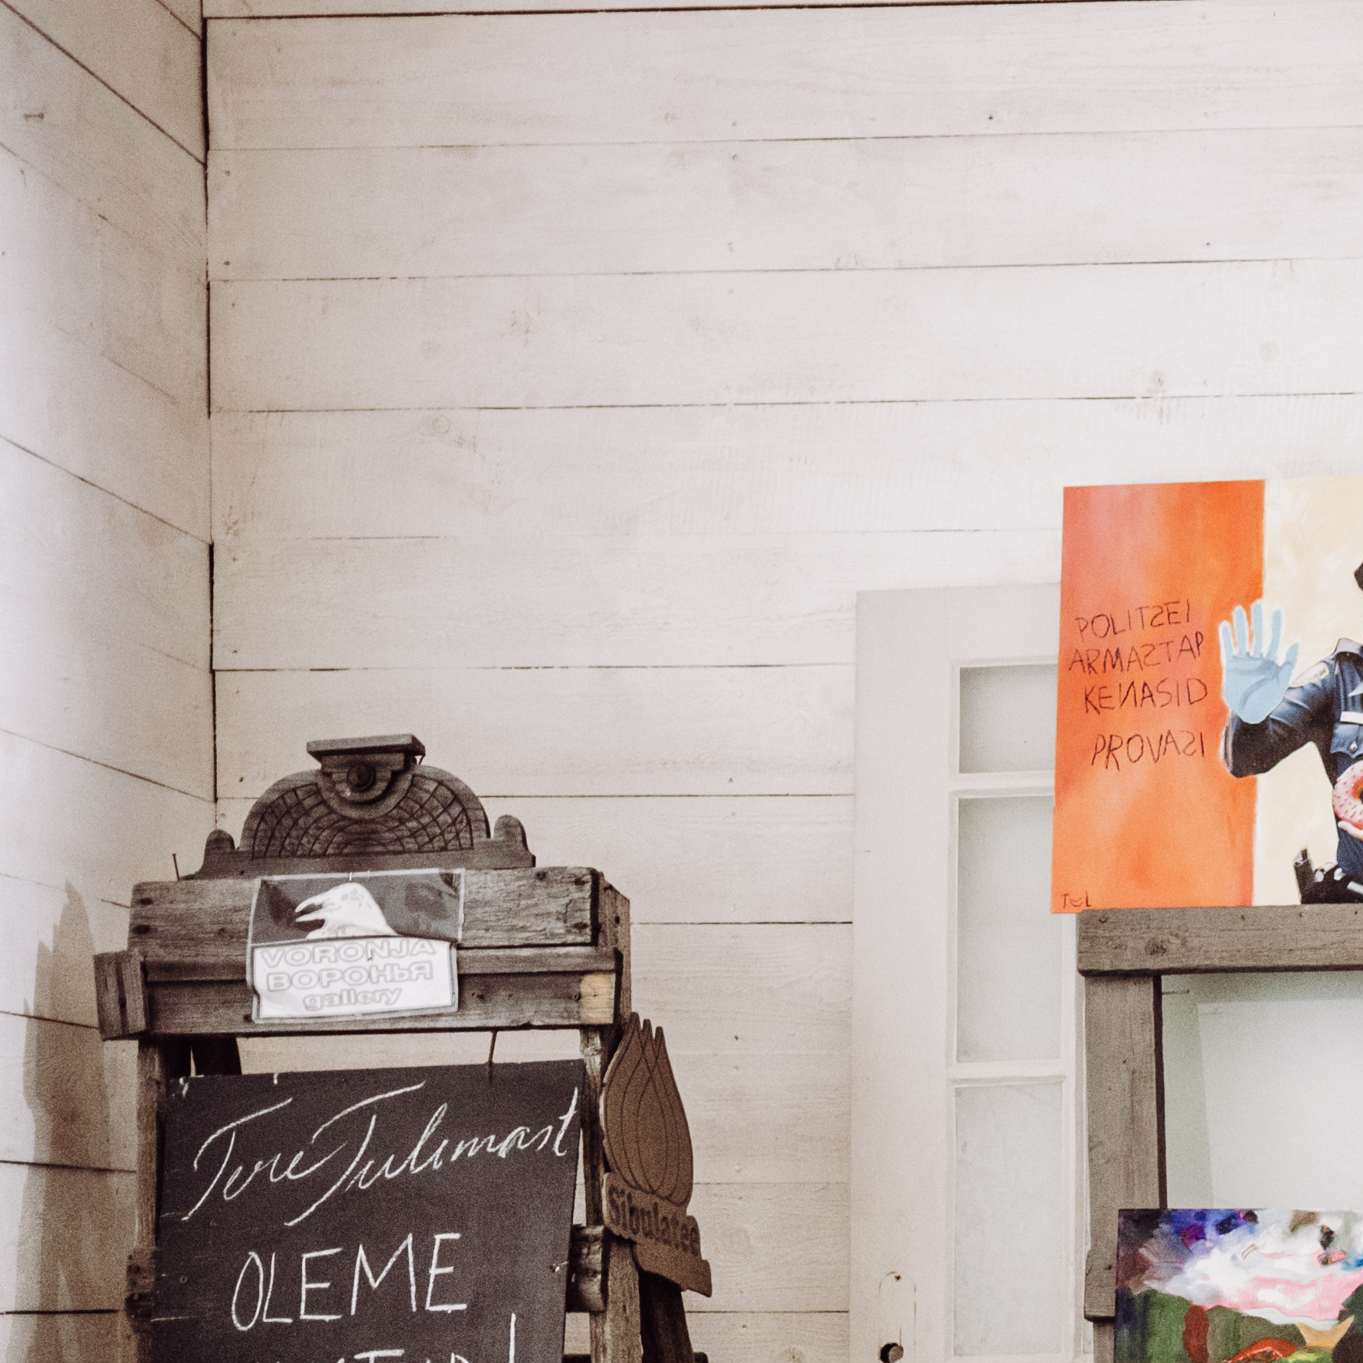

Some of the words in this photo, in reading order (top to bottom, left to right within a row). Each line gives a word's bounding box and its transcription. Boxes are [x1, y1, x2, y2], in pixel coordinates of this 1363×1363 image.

[262, 938, 437, 968] VORONJA
[302, 987, 402, 1012] gallery
[181, 1098, 347, 1222] Tere
[231, 1232, 468, 1332] OLEME
